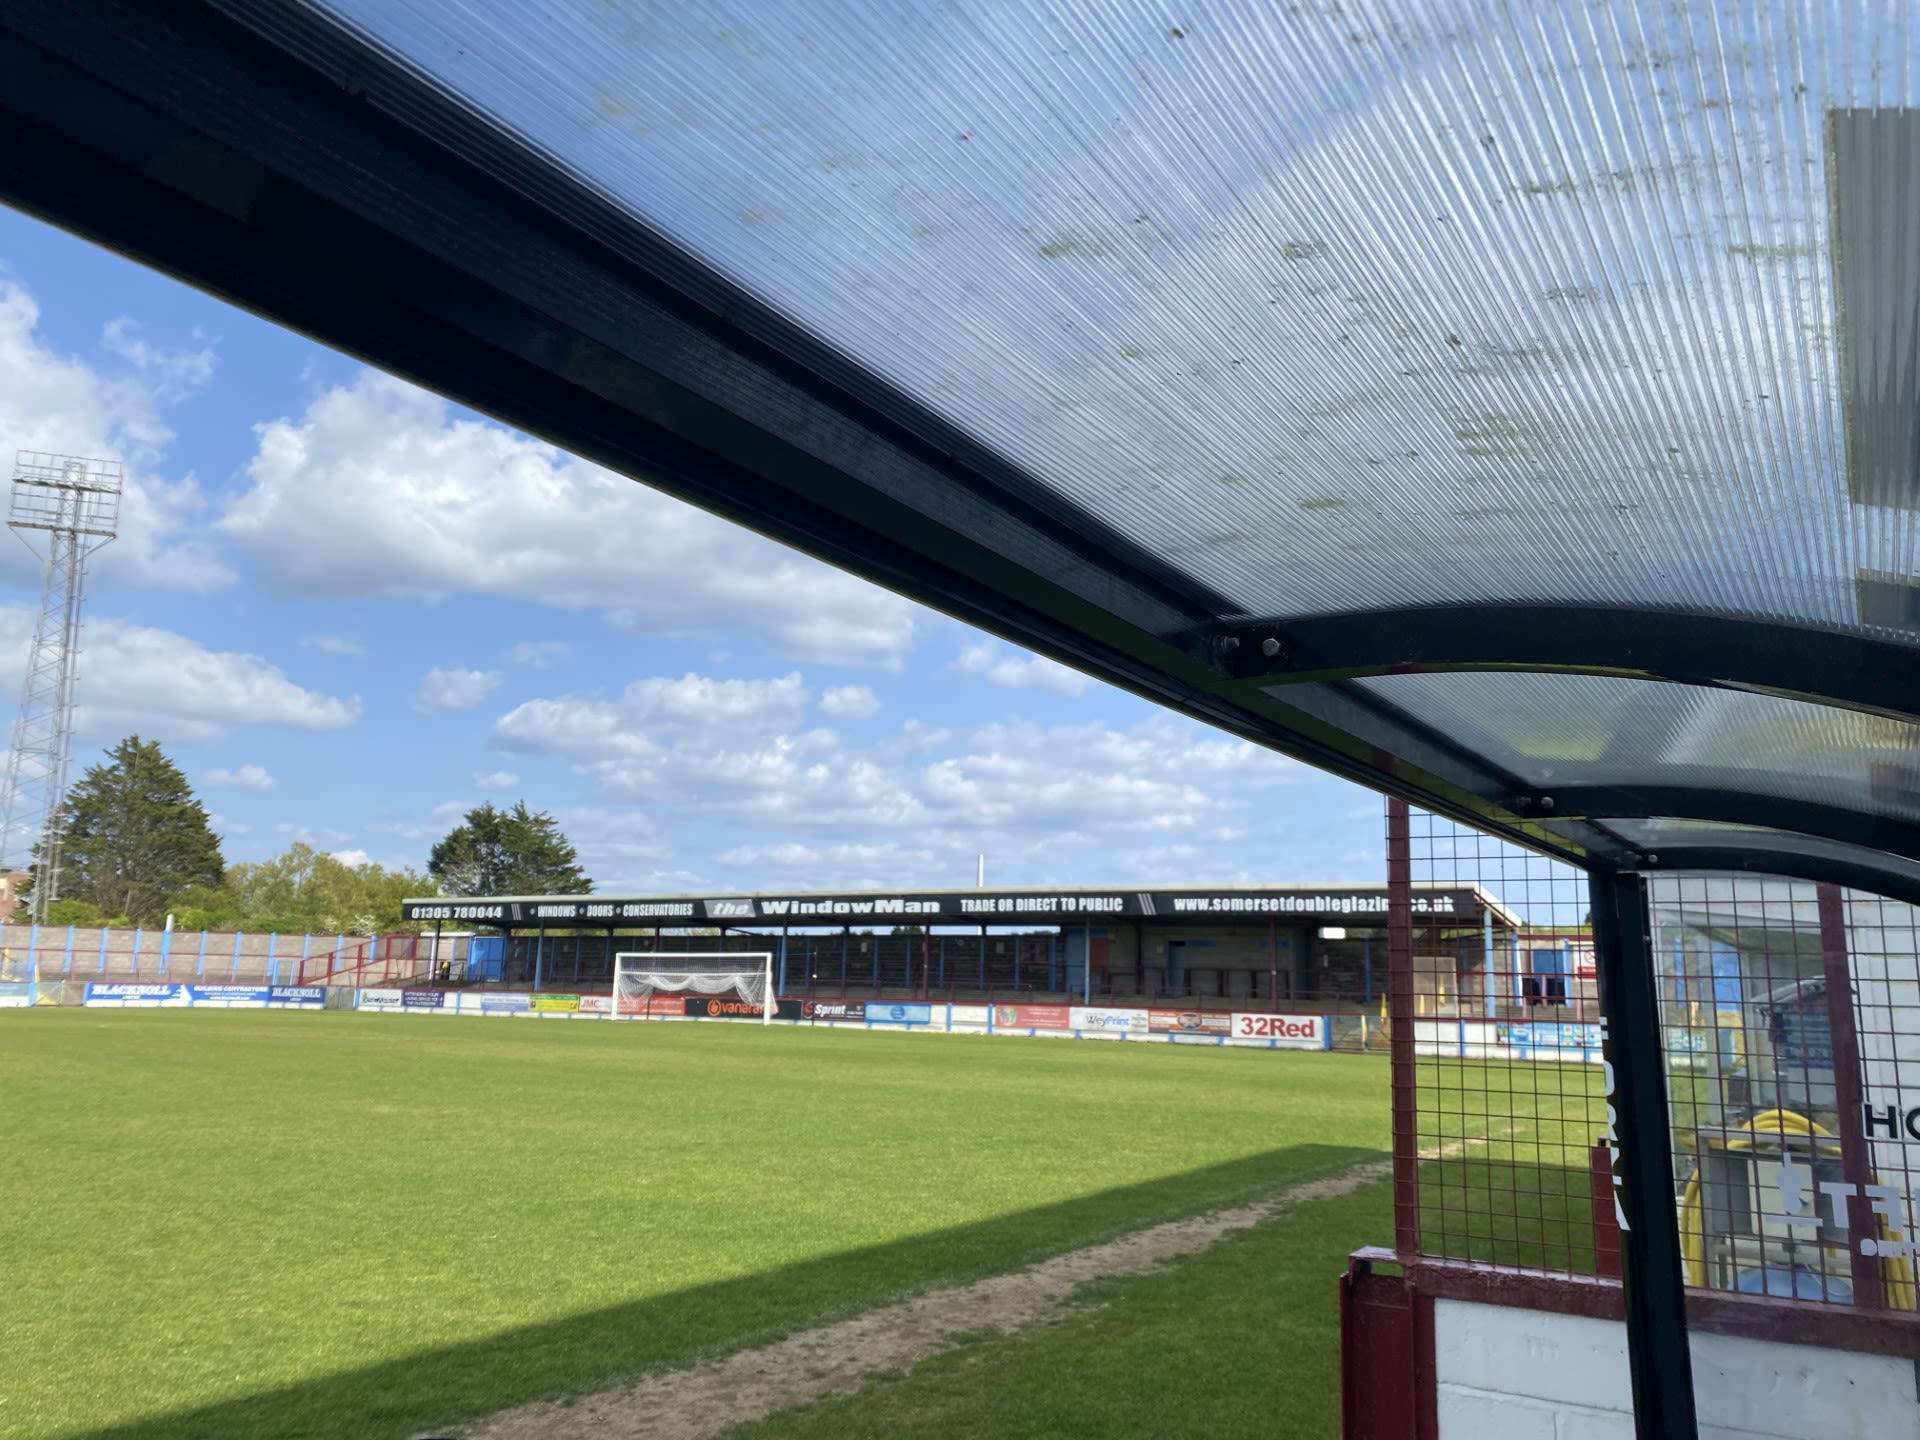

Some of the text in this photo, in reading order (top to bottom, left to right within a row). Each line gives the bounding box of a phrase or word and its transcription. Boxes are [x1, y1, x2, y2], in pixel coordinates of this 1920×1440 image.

[537, 904, 693, 917] WINDOWS DOORS CONSERVATORIES
[713, 900, 940, 915] the WindowMan
[961, 897, 1123, 912] TRADE OR DIRECT TO PUBLIC
[411, 906, 503, 919] 01305 780044
[581, 1000, 599, 1009] JMC
[815, 1003, 846, 1018] Sprint
[1241, 1016, 1315, 1038] 32Red
